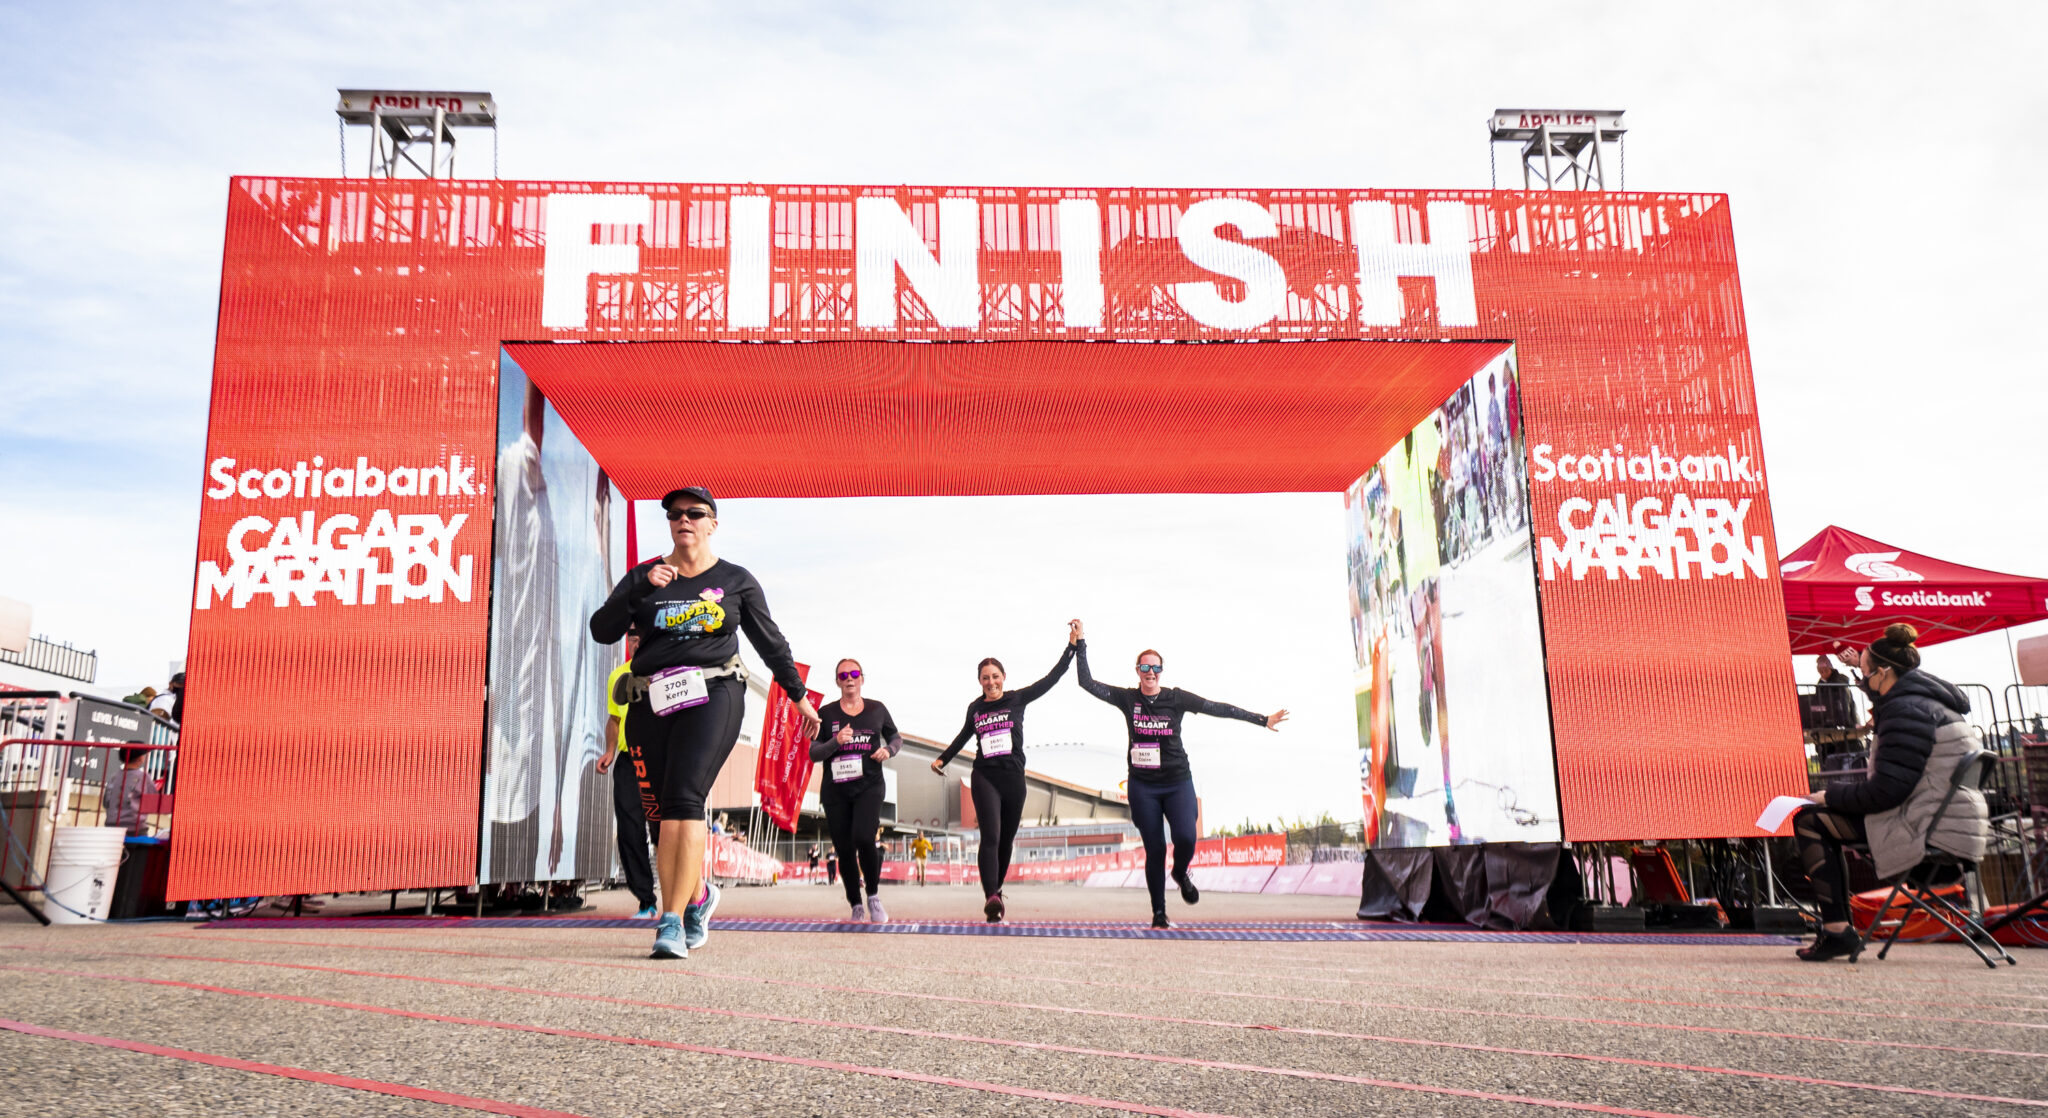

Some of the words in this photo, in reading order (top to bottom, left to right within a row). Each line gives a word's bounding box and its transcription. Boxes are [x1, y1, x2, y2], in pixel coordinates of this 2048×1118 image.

[541, 193, 1478, 328] FINISH
[1558, 493, 1752, 540] CALGARY
[227, 509, 469, 558] CALGARY
[1540, 533, 1768, 580] MARATHON
[196, 552, 473, 609] MARATHON
[666, 603, 716, 627] DOPEY
[664, 680, 687, 691] 3708
[666, 689, 689, 701] Kerry
[975, 714, 1009, 729] CALGARY
[1133, 720, 1169, 728] CALGARY
[1134, 728, 1173, 736] TOGETHER
